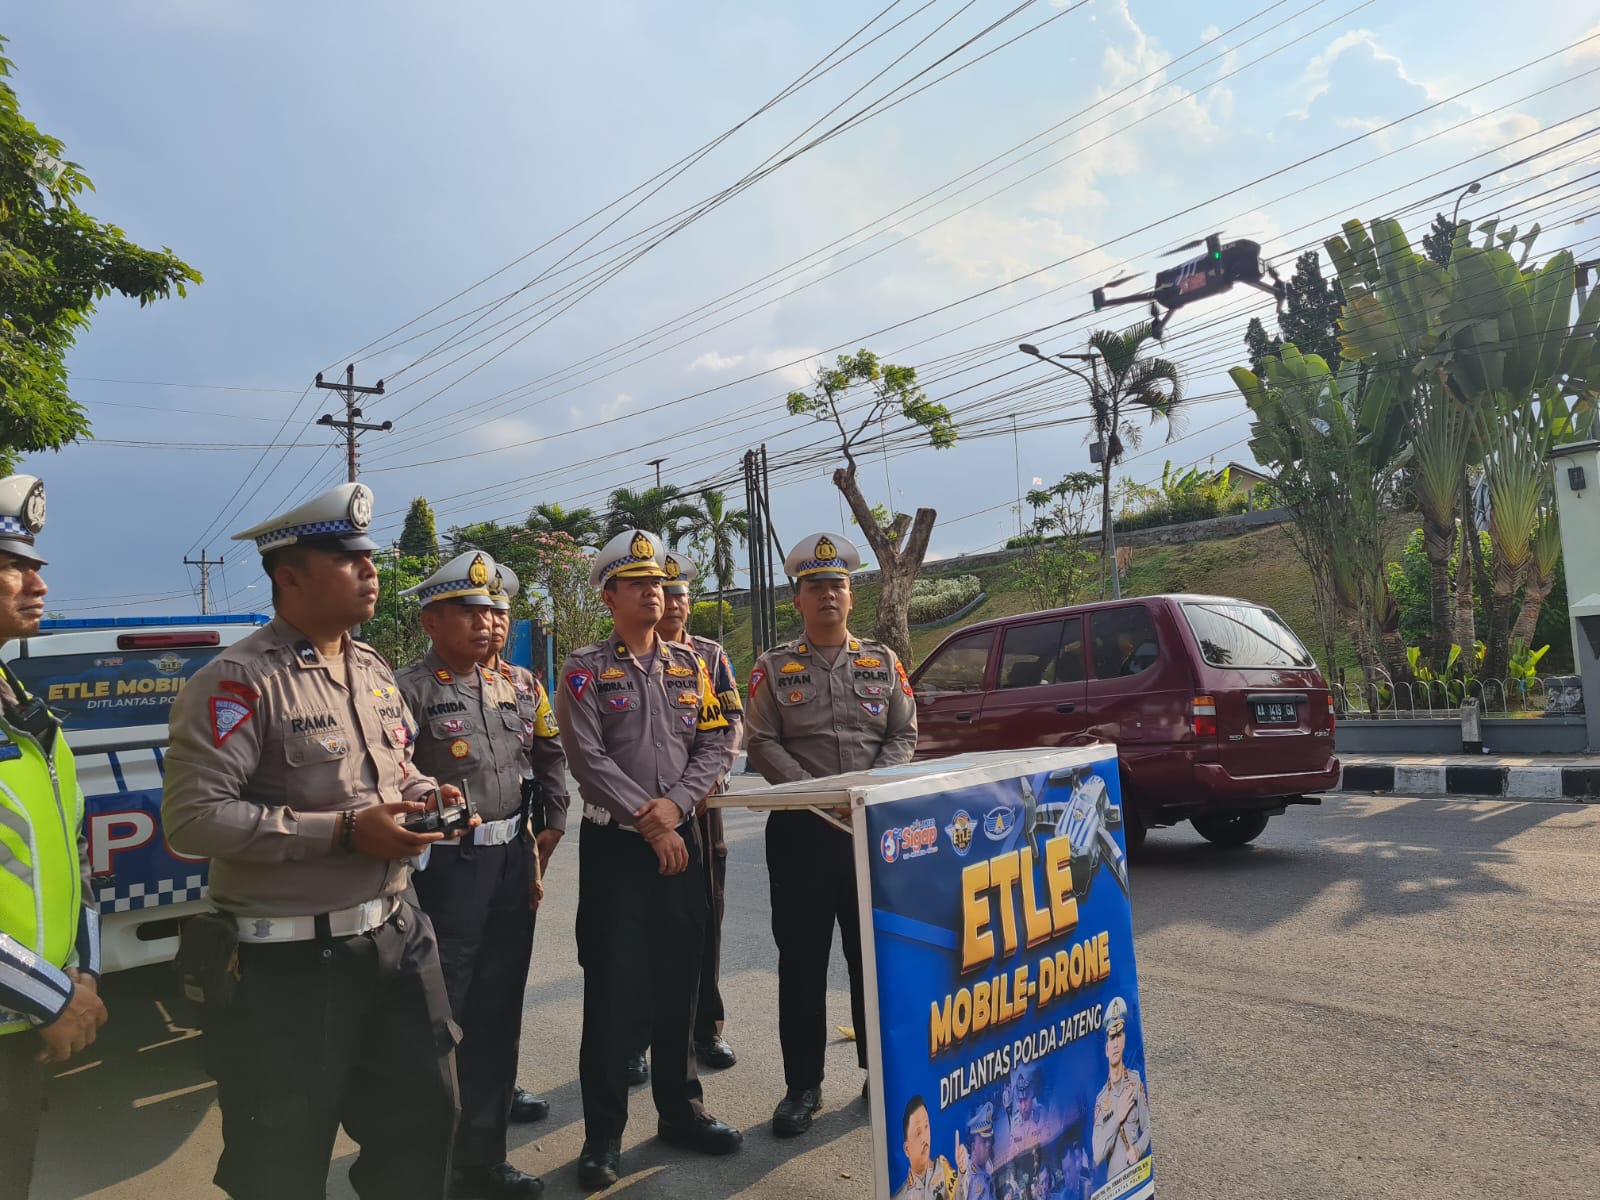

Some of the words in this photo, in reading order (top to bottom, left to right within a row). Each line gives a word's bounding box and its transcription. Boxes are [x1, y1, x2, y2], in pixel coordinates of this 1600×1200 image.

[778, 675, 811, 687] RYAN
[854, 671, 888, 681] POLRI
[48, 681, 110, 700] ETLE
[87, 696, 157, 709] DITLANTAS
[427, 701, 467, 716] KRIDA
[292, 714, 337, 733] RAMA
[902, 826, 938, 852] Sigap
[953, 828, 972, 845] ETLE
[961, 834, 1079, 975] ETLE
[930, 931, 1111, 1057] MOBILE-DRONE
[940, 1044, 1011, 1110] DITLANTAS
[1013, 1024, 1056, 1069] POLDA
[1058, 1003, 1102, 1047] JATENG
